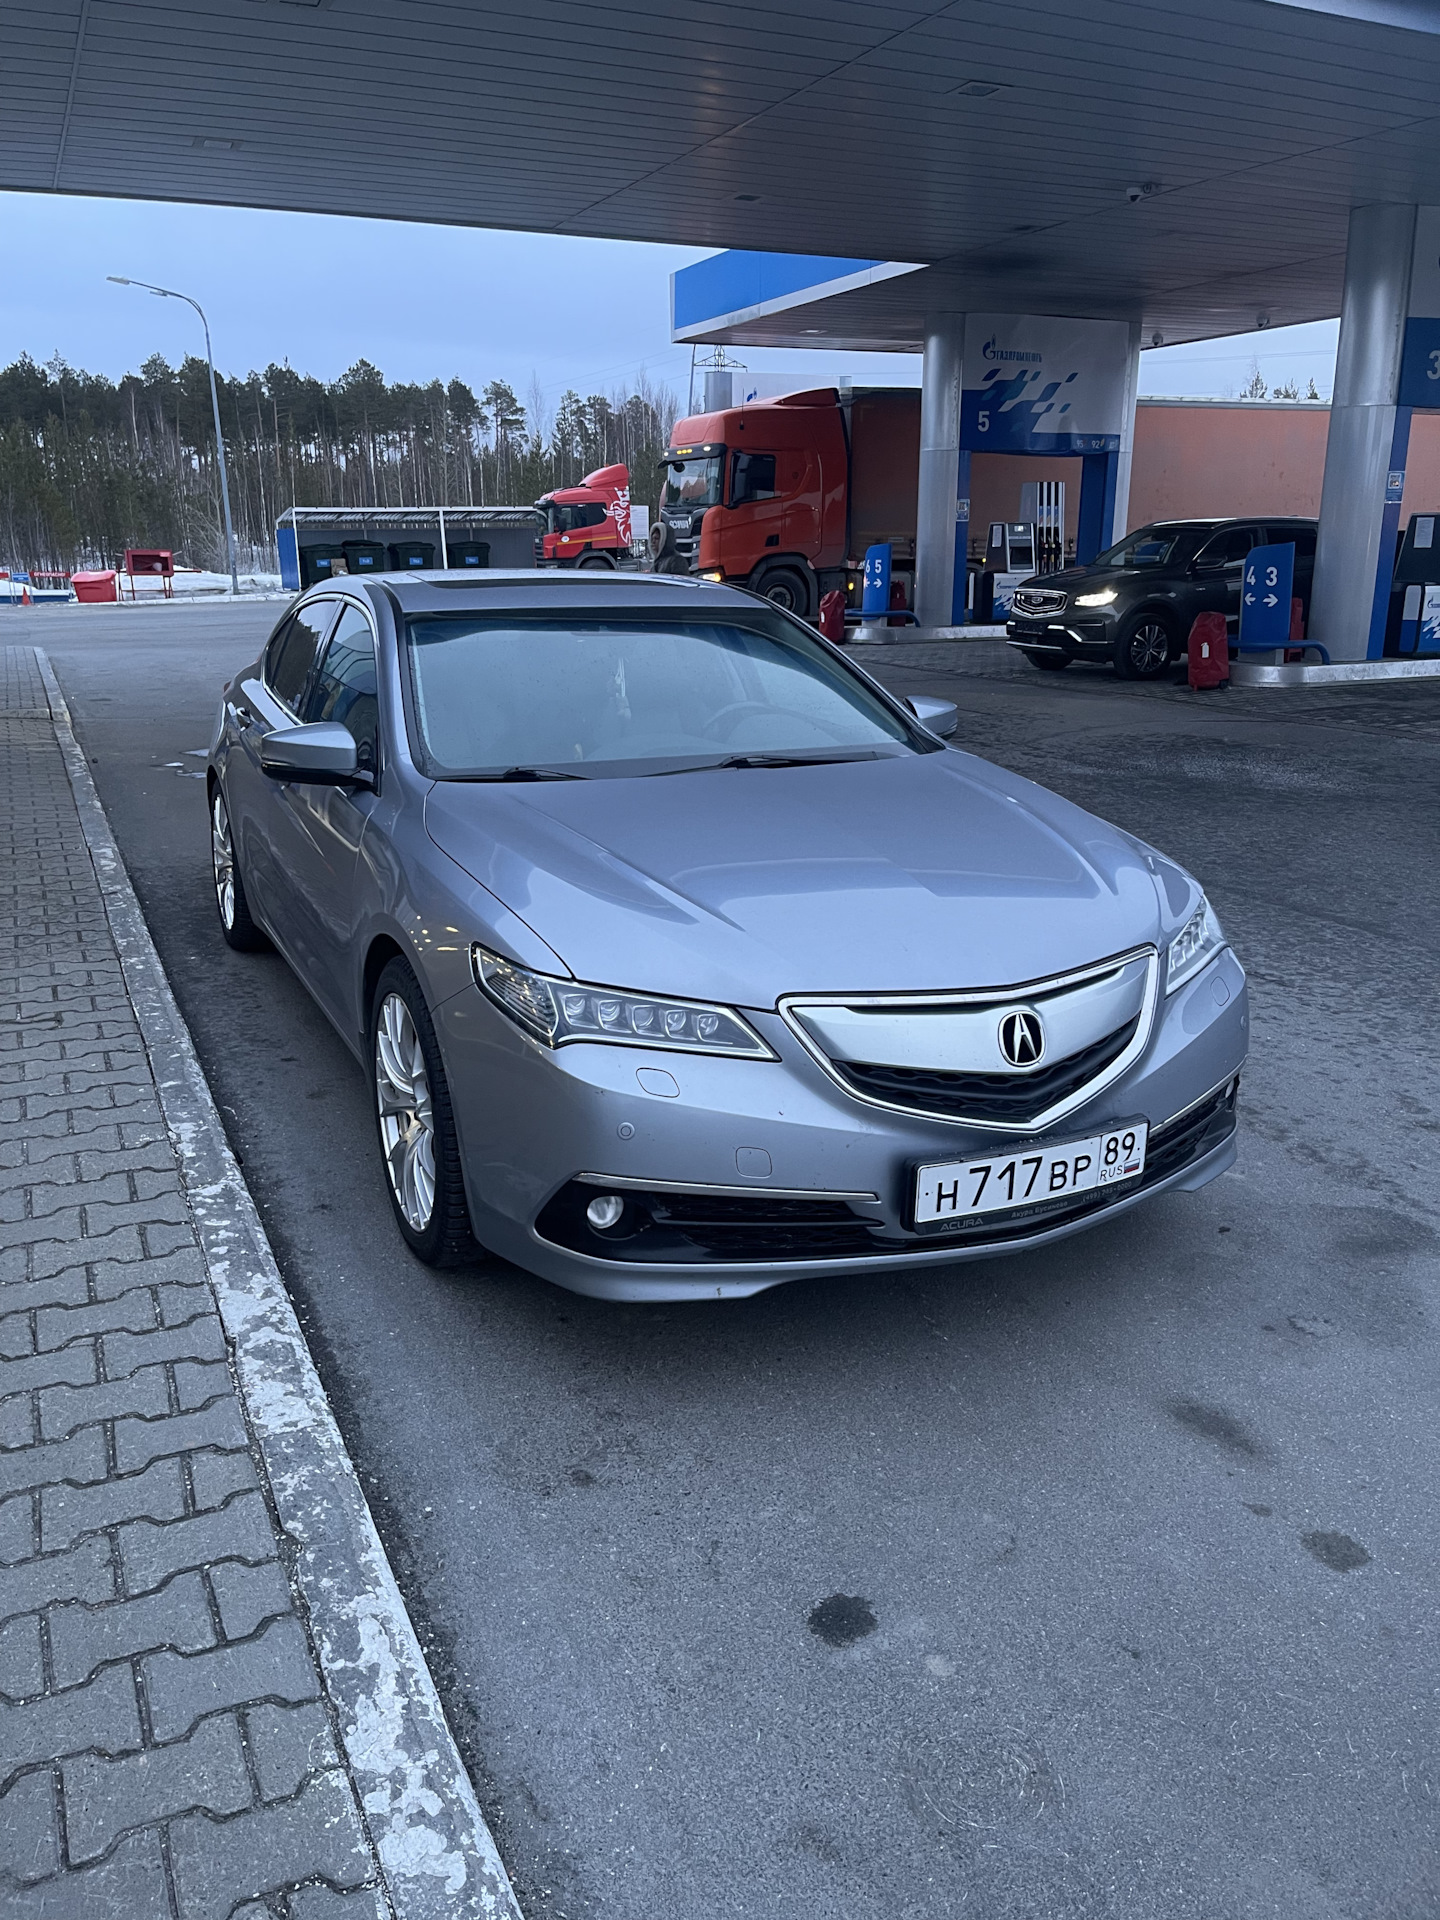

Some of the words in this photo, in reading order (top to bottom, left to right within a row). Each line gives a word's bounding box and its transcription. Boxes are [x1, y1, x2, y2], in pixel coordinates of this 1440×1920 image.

[1426, 350, 1440, 380] 3
[977, 410, 990, 432] 5
[1091, 440, 1100, 449] 92
[865, 559, 871, 574] 6
[874, 559, 882, 574] 5
[1246, 565, 1256, 586] 4
[1265, 566, 1278, 587] 3
[1104, 1132, 1136, 1166] 89
[1099, 1165, 1123, 1182] RUS
[940, 1217, 984, 1231] ACURA
